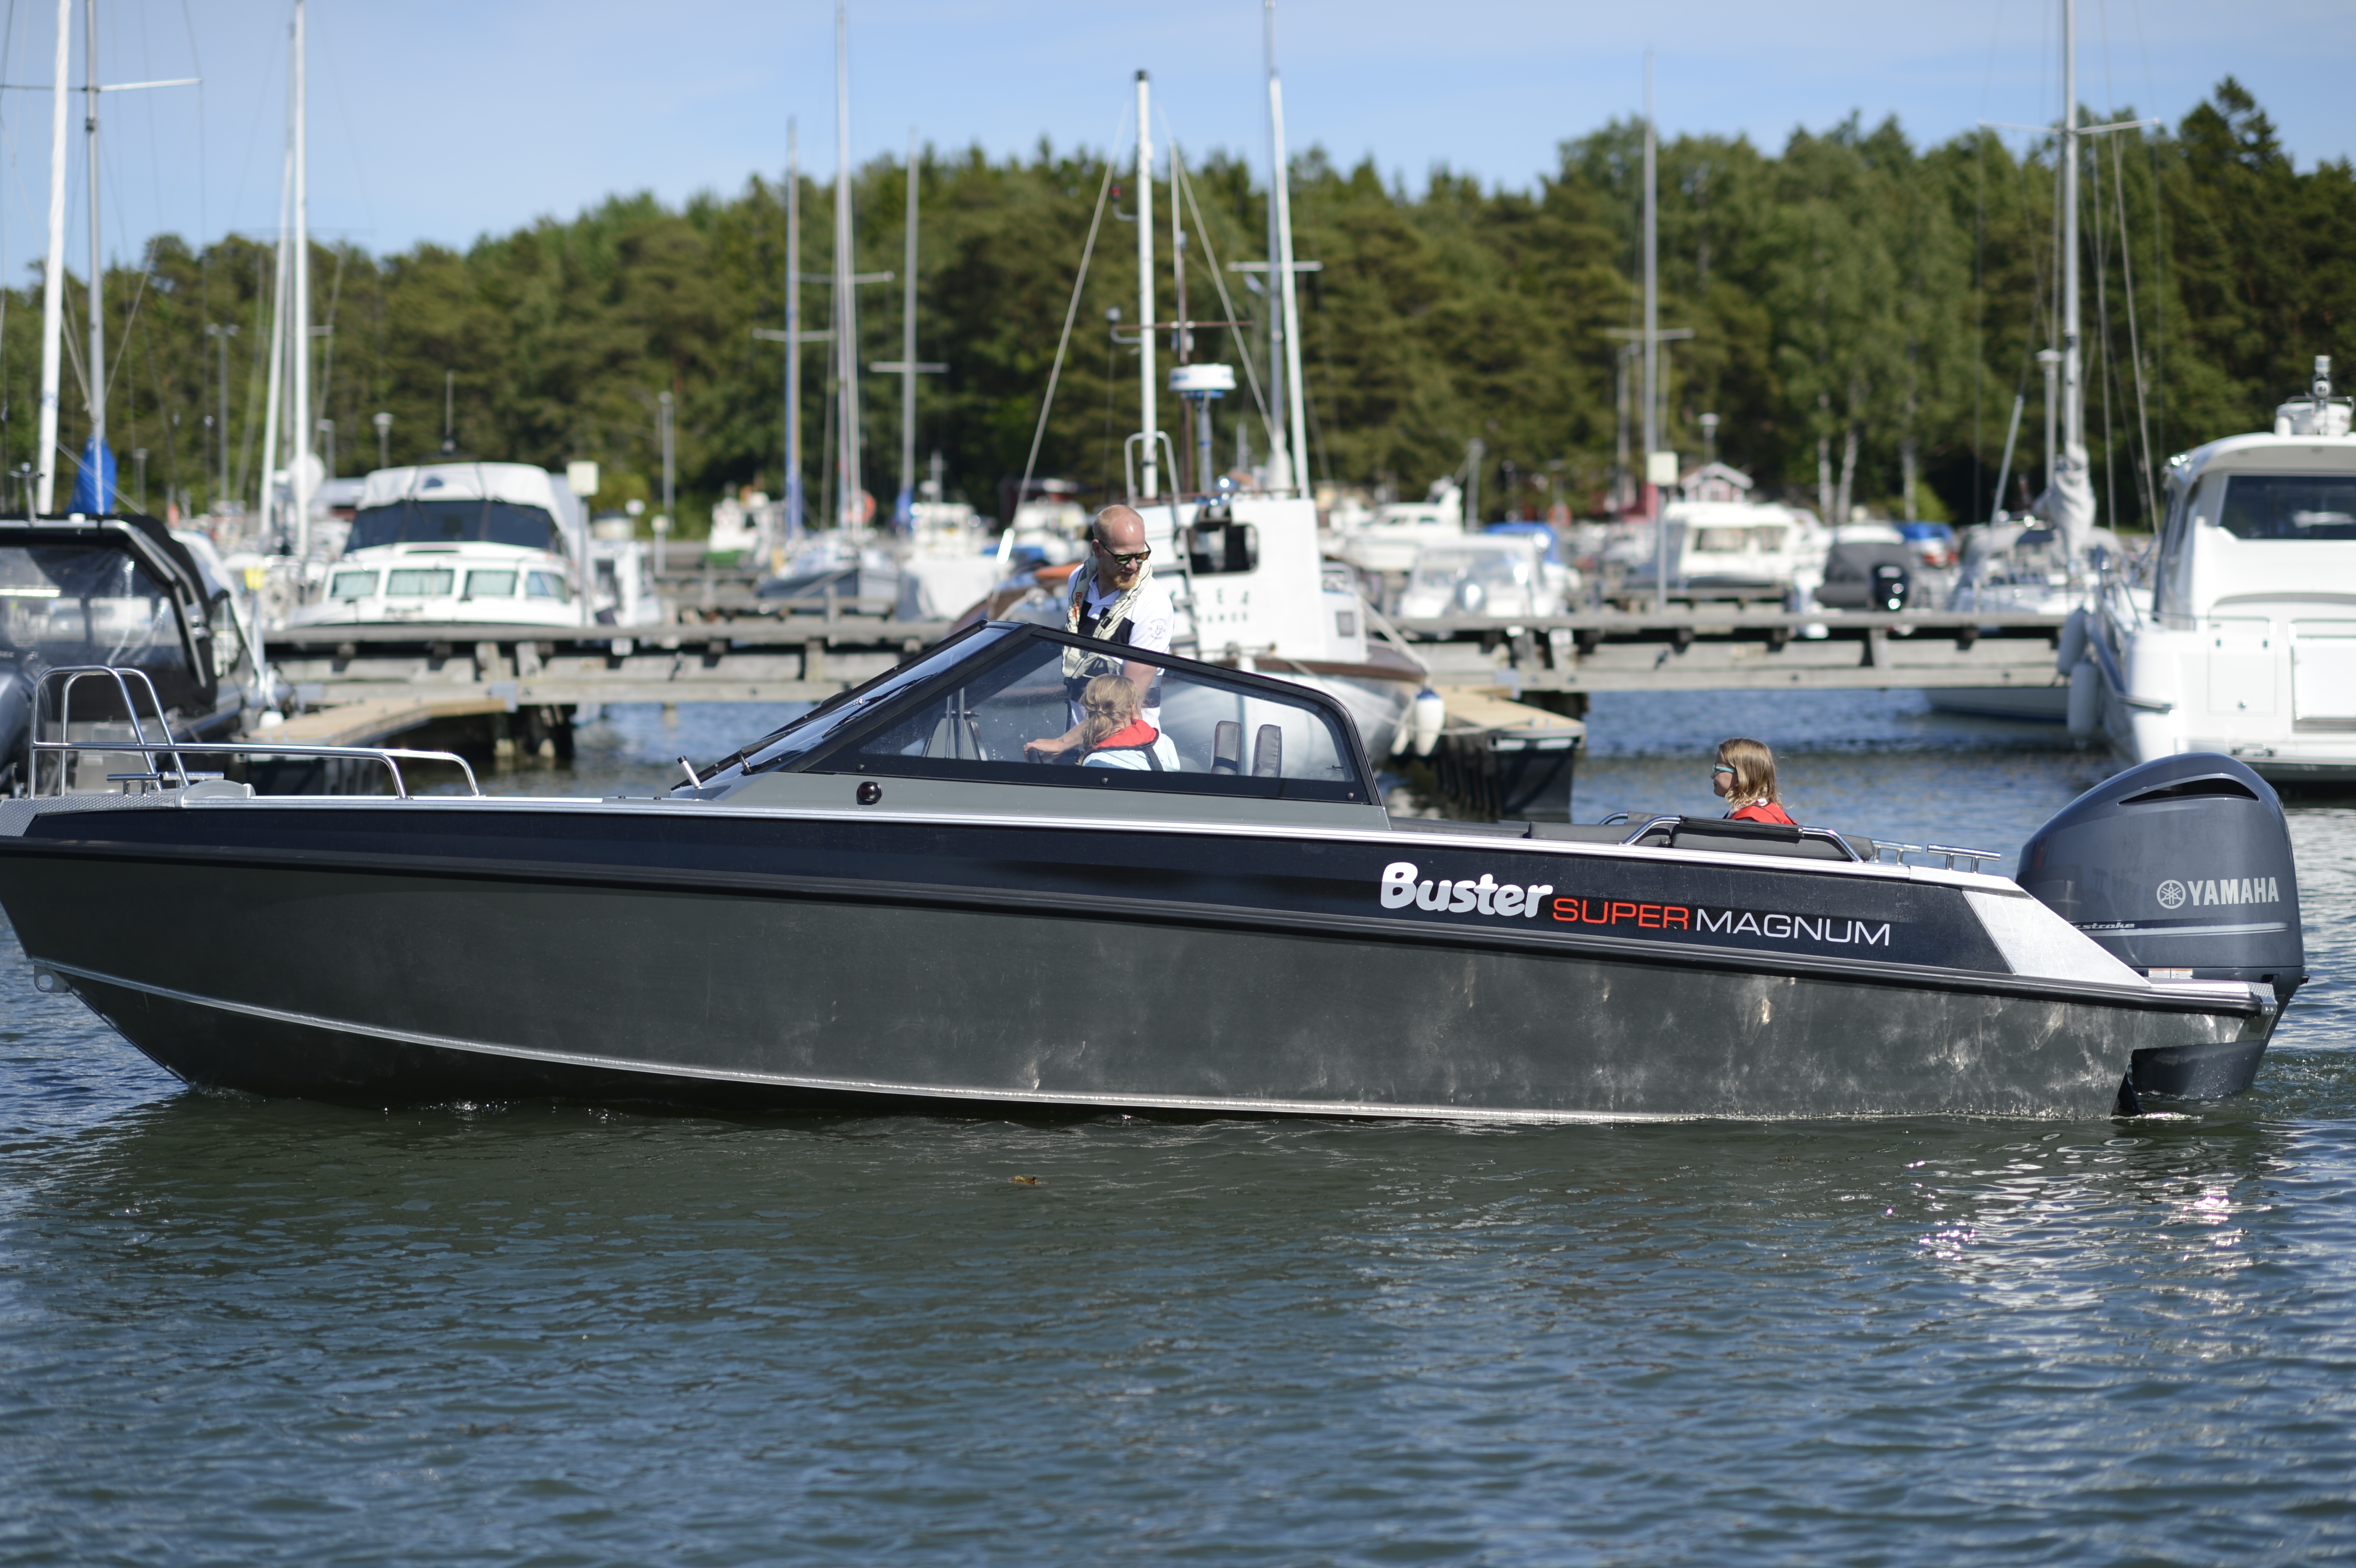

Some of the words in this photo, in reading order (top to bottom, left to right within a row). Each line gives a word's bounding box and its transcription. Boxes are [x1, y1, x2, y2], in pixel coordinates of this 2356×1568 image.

[1381, 862, 1553, 918] Buster
[1553, 898, 1689, 931] SUPER
[1697, 909, 1890, 946] MAGNUM
[2187, 877, 2279, 906] YAMAHA
